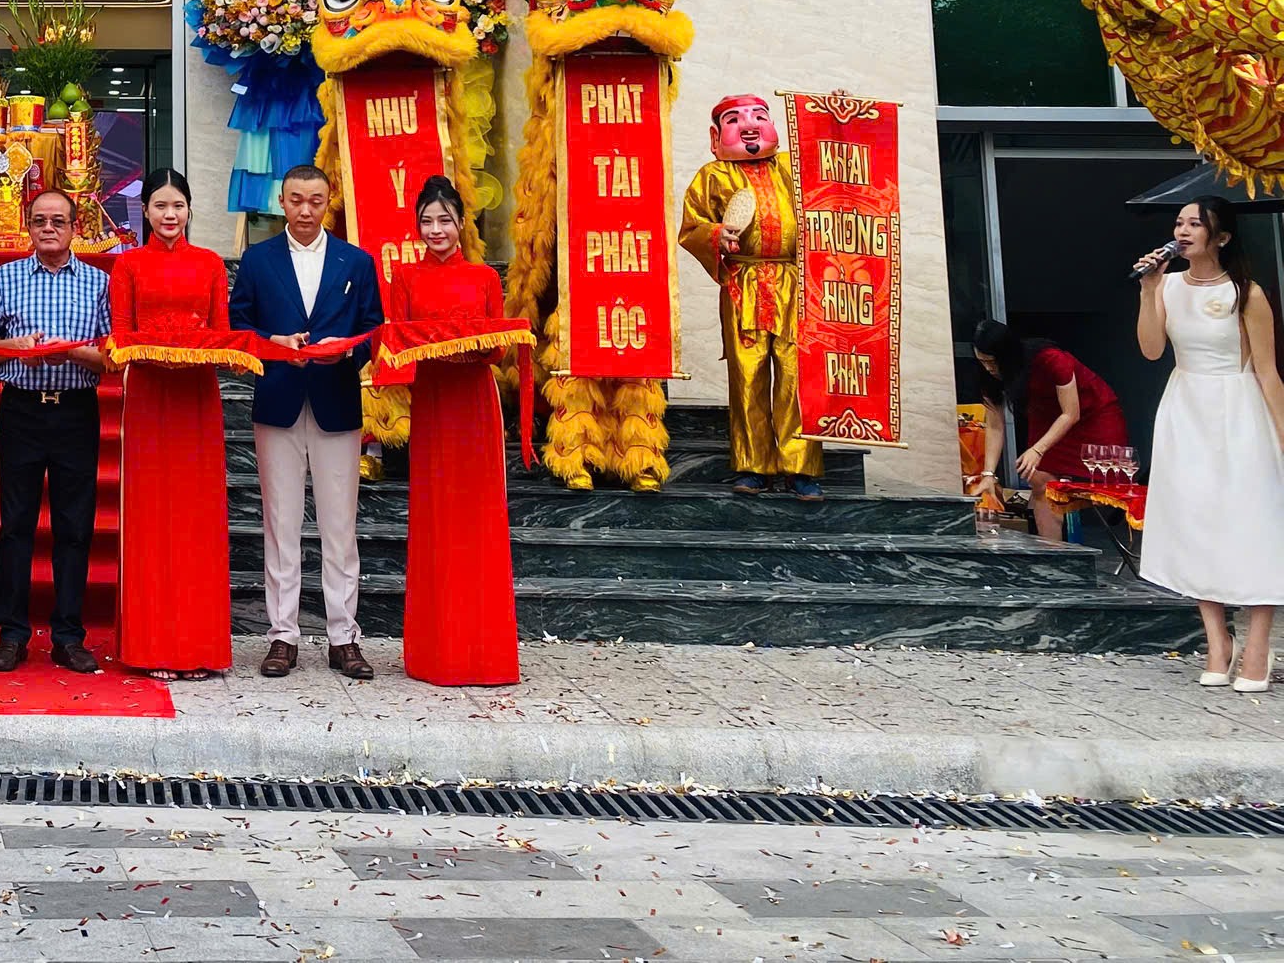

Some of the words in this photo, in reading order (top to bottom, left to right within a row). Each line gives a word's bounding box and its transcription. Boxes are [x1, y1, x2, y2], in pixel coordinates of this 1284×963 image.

[366, 90, 418, 138] NHƯ
[581, 77, 644, 124] PHÁT
[390, 160, 406, 208] Ý
[593, 148, 641, 197] TÀI
[819, 140, 870, 186] KHAI
[586, 223, 652, 273] PHÁT
[805, 207, 889, 257] TRƯƠNG
[821, 267, 875, 326] HỒNG
[597, 297, 647, 355] LỘC
[825, 345, 871, 397] PHÁT
